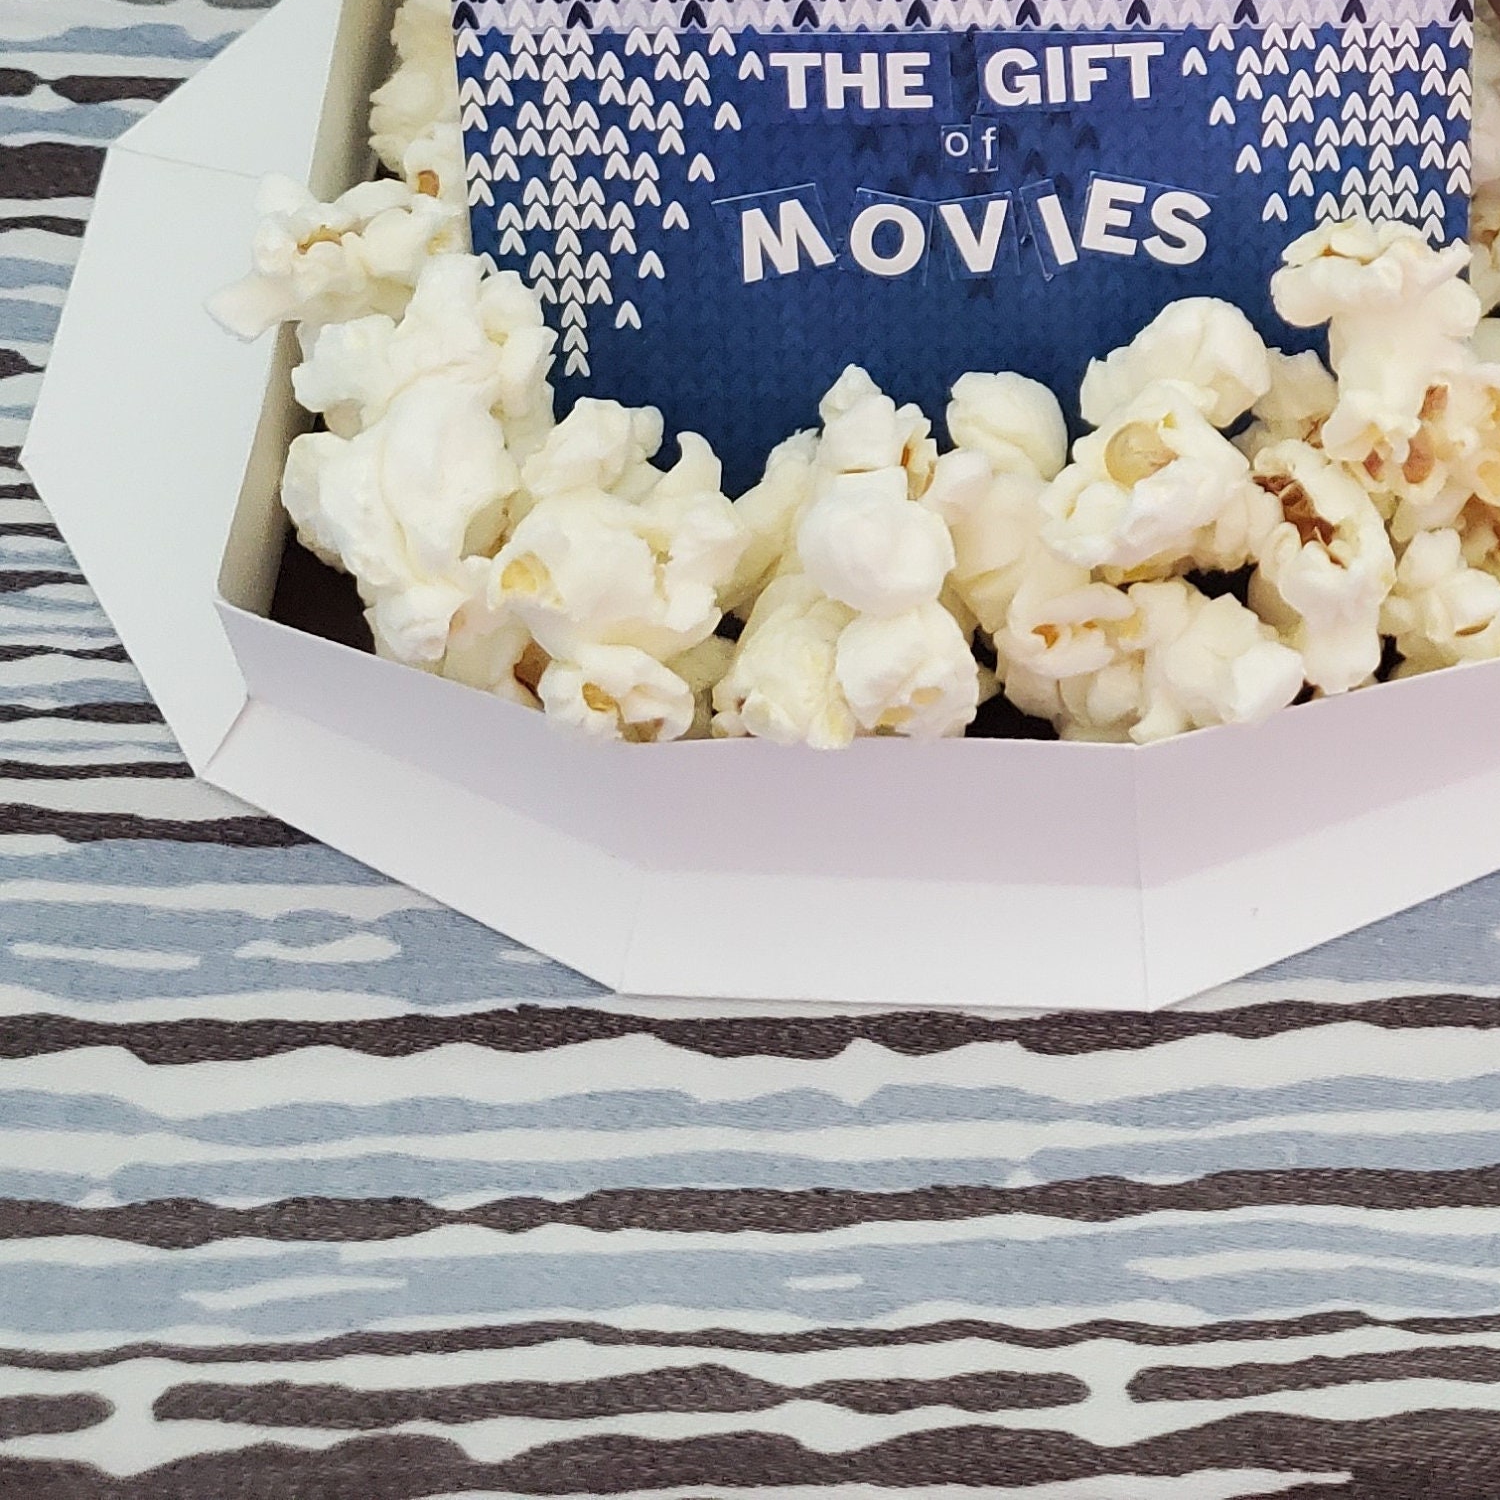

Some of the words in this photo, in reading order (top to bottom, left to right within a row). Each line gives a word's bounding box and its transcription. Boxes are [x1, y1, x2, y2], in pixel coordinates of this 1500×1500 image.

[770, 52, 934, 109] THE
[984, 42, 1165, 106] GIFT
[944, 126, 997, 161] of
[742, 178, 1212, 284] MOVIES
